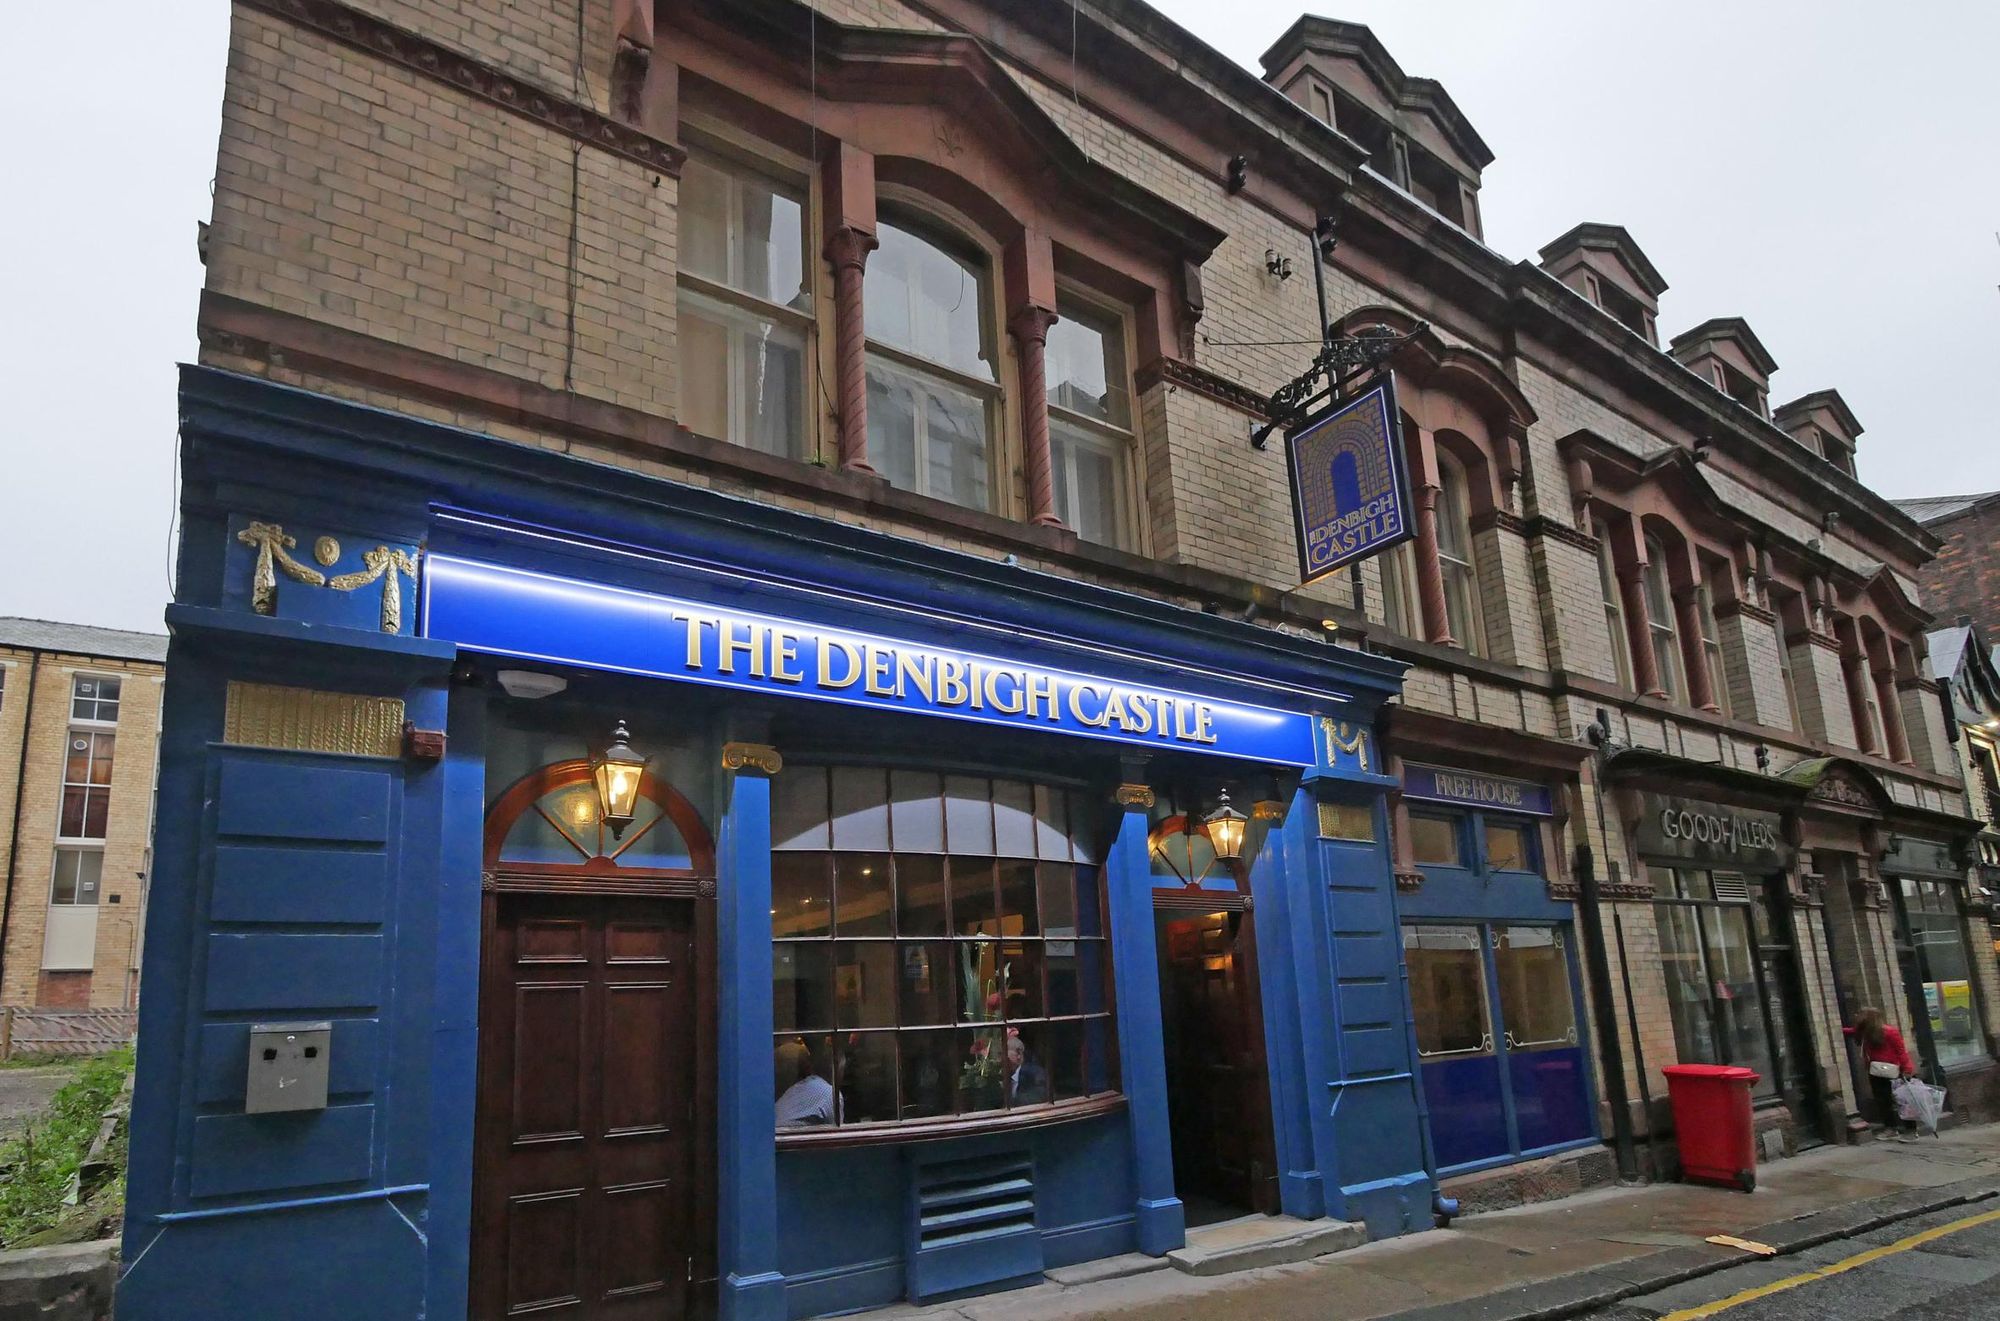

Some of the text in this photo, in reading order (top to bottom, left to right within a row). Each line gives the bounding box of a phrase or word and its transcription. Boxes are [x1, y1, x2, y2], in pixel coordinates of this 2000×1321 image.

[1311, 511, 1398, 564] CASTLE
[1314, 493, 1394, 543] DENBIGH
[671, 611, 1219, 744] THE DENBIGH CASTLE
[1434, 773, 1522, 806] FREE HOUSE
